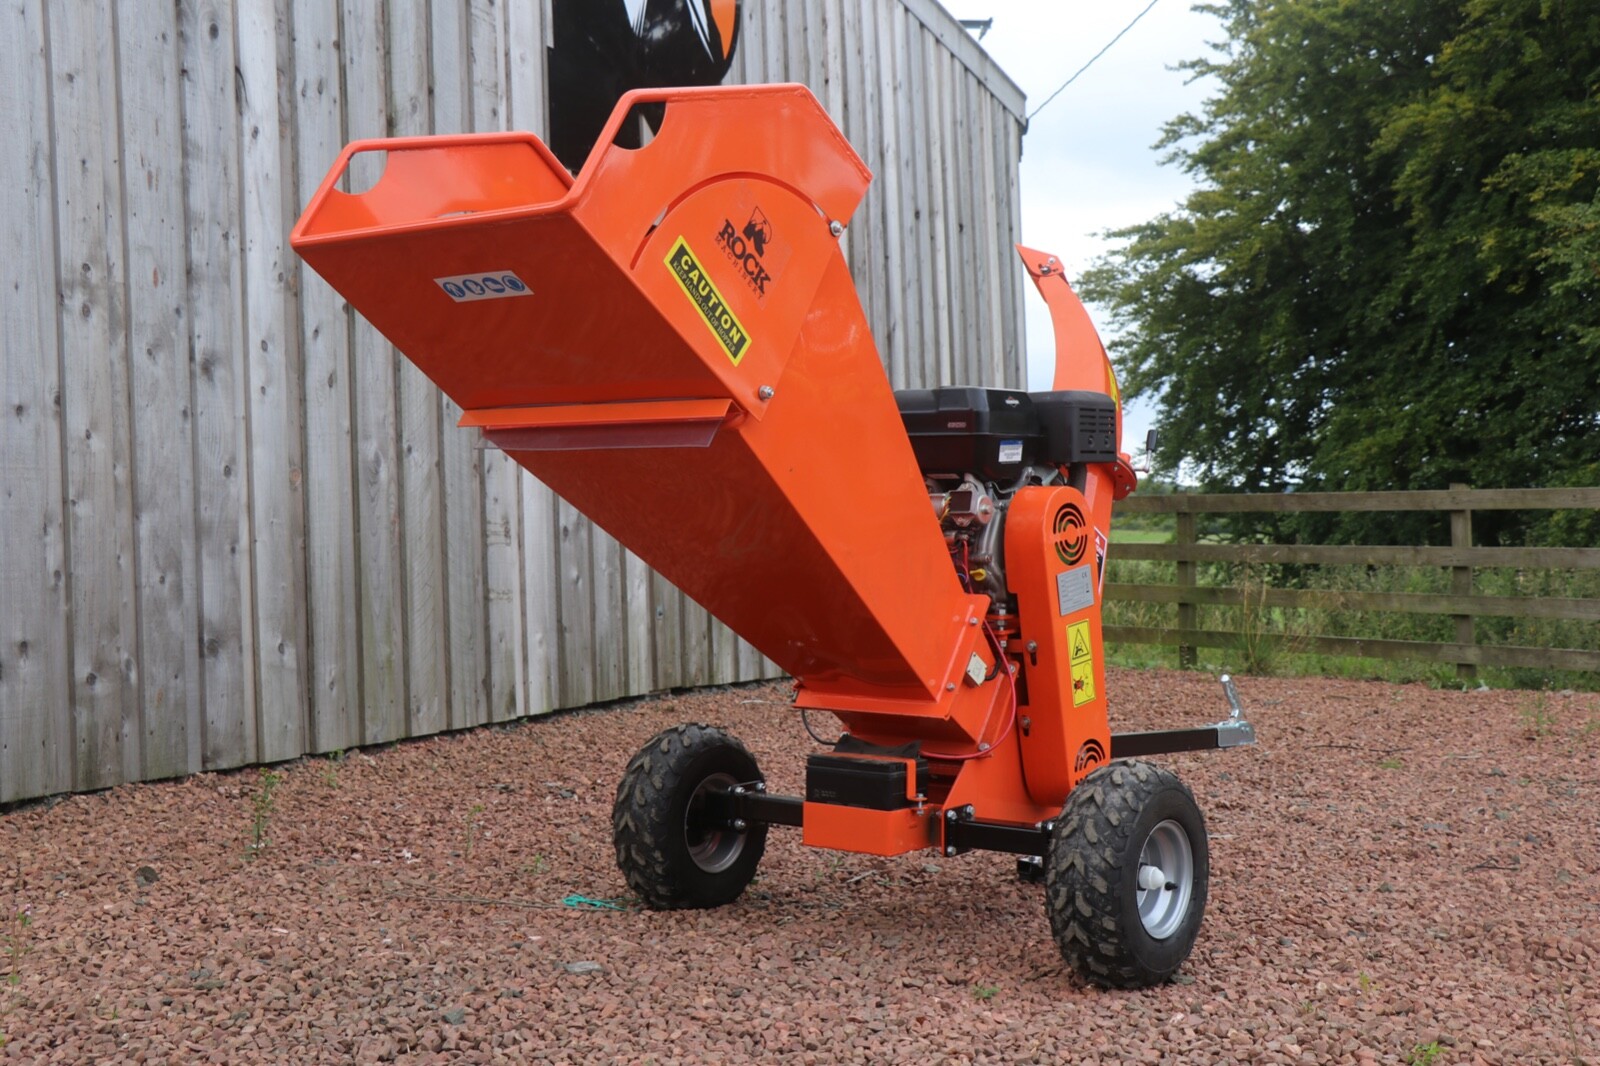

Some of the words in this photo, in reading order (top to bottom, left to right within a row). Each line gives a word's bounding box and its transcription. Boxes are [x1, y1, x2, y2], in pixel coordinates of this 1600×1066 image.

[681, 254, 741, 345] CAUTION
[718, 218, 771, 295] ROCK
[673, 260, 687, 281] KEEP
[684, 277, 702, 305] HANDS
[700, 302, 713, 319] OUT
[710, 316, 720, 329] OF
[717, 326, 736, 353] HOPPER
